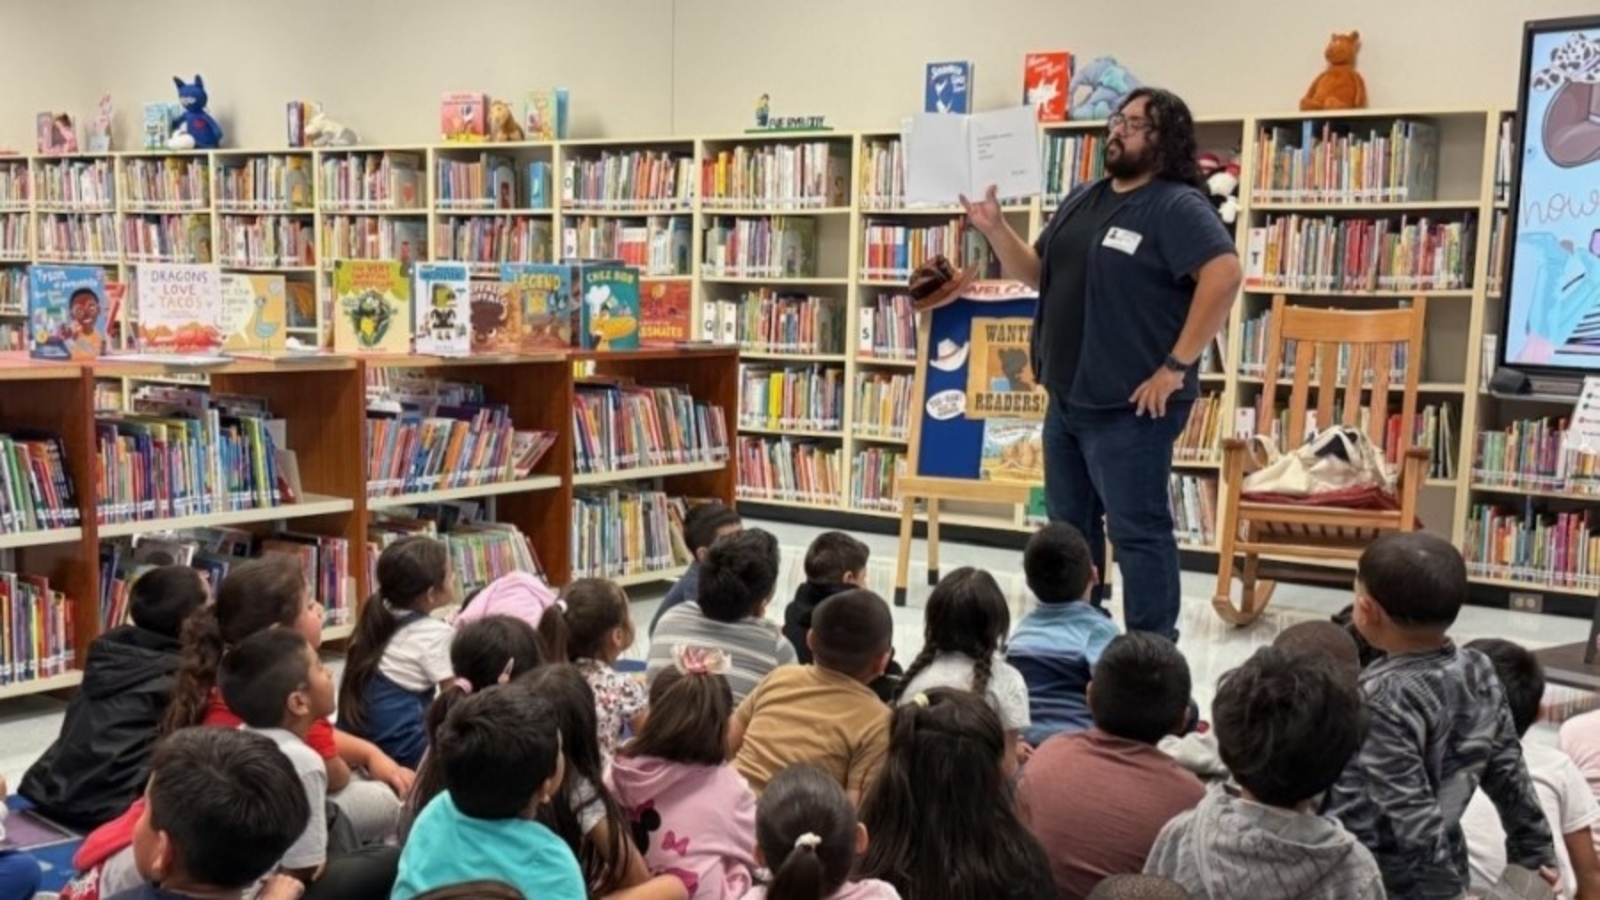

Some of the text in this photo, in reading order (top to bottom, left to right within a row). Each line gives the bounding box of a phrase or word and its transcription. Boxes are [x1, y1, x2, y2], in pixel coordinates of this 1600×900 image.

[1252, 251, 1260, 265] T
[151, 270, 208, 283] DRAGONS
[513, 272, 561, 290] LEGEND
[586, 269, 612, 283] CHEZ
[163, 284, 197, 295] LOVE
[160, 297, 201, 308] TACOS
[704, 320, 714, 332] Q
[862, 327, 870, 340] S
[975, 392, 1046, 413] READERS!
